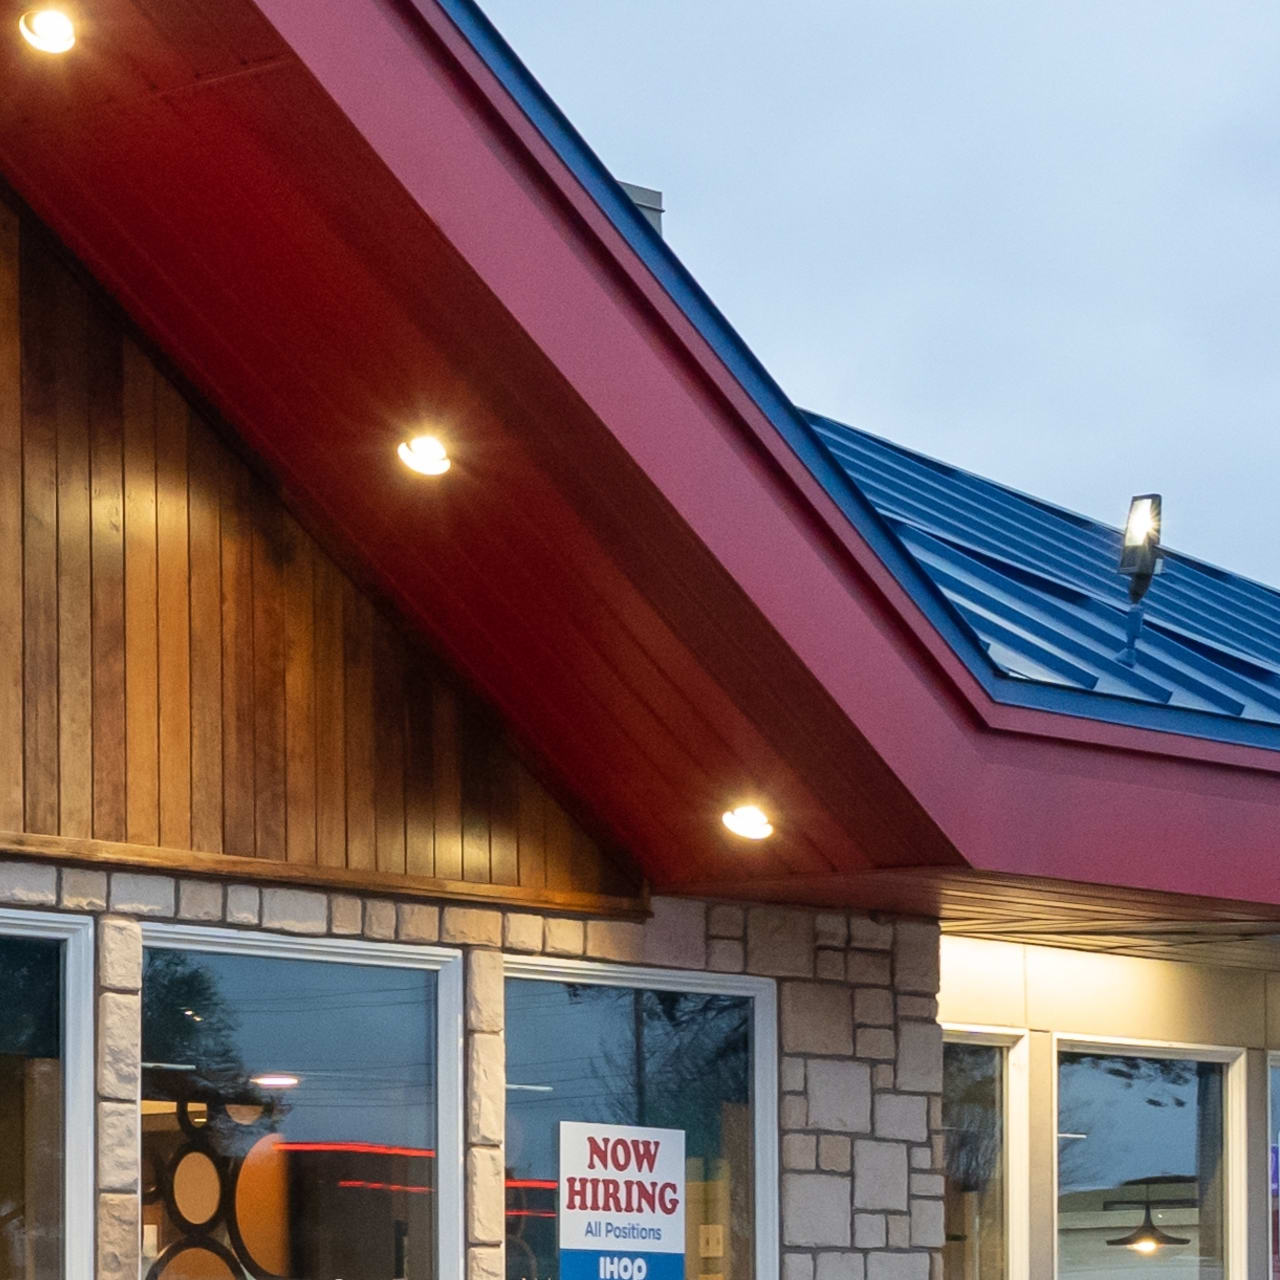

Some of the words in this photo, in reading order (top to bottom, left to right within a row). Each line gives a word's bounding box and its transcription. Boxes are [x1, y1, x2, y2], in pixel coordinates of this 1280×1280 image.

[586, 1136, 661, 1174] NOW
[566, 1177, 680, 1216] HIRING
[585, 1221, 602, 1238] All
[605, 1223, 663, 1241] Positions
